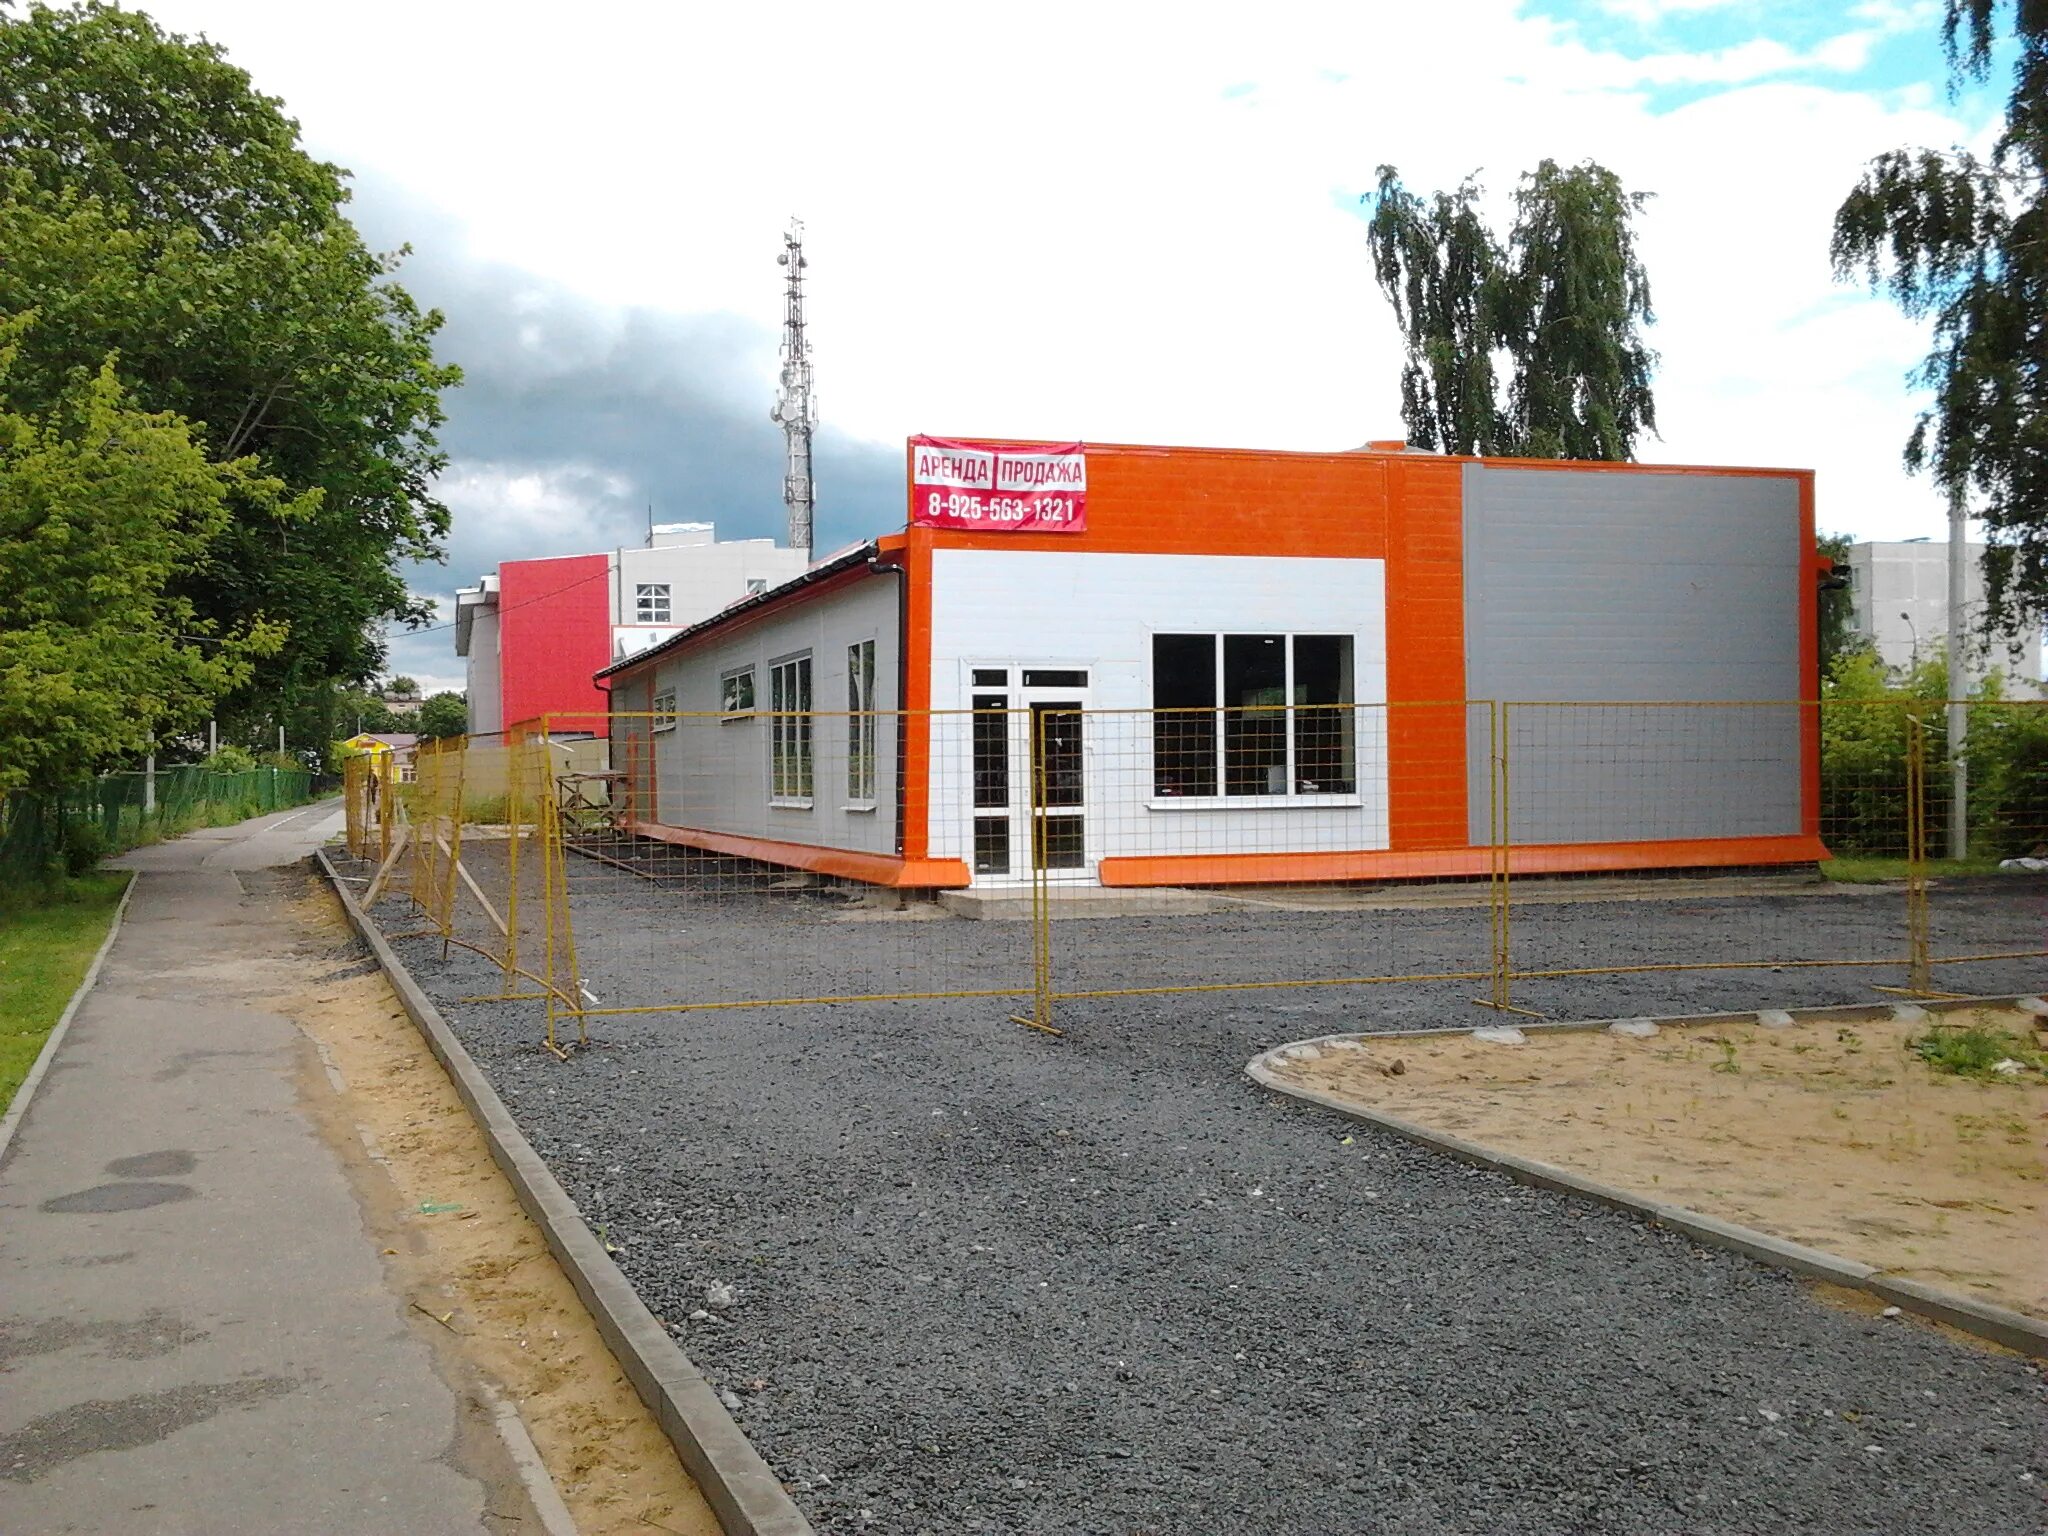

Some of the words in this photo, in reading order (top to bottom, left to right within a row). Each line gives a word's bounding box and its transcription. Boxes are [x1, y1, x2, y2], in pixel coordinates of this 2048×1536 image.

[919, 455, 988, 483] АРЕНДА
[1002, 460, 1083, 485] ПРОДАЖА
[928, 492, 1073, 521] 8-925-563-1321
